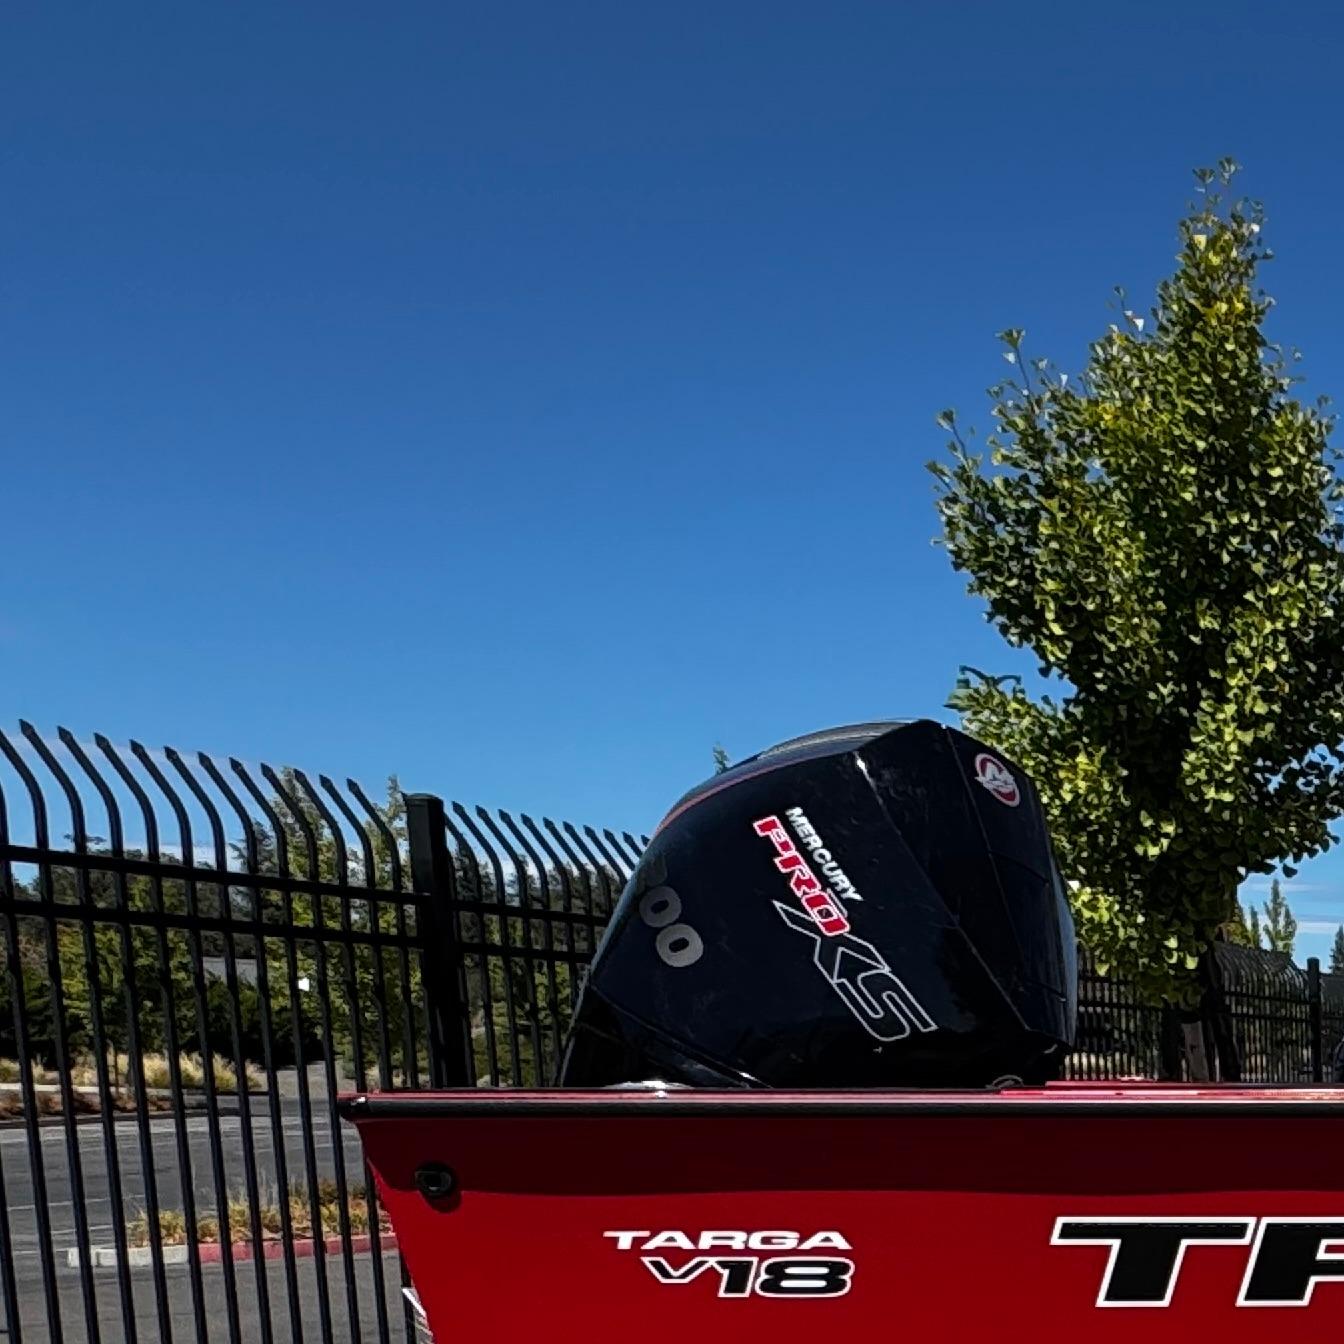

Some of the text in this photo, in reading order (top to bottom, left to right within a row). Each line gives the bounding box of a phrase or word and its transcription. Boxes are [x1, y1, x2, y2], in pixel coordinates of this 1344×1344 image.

[785, 807, 864, 901] MERCURY
[773, 900, 938, 1041] XS
[603, 1231, 852, 1250] TARGA
[640, 1256, 855, 1298] V18
